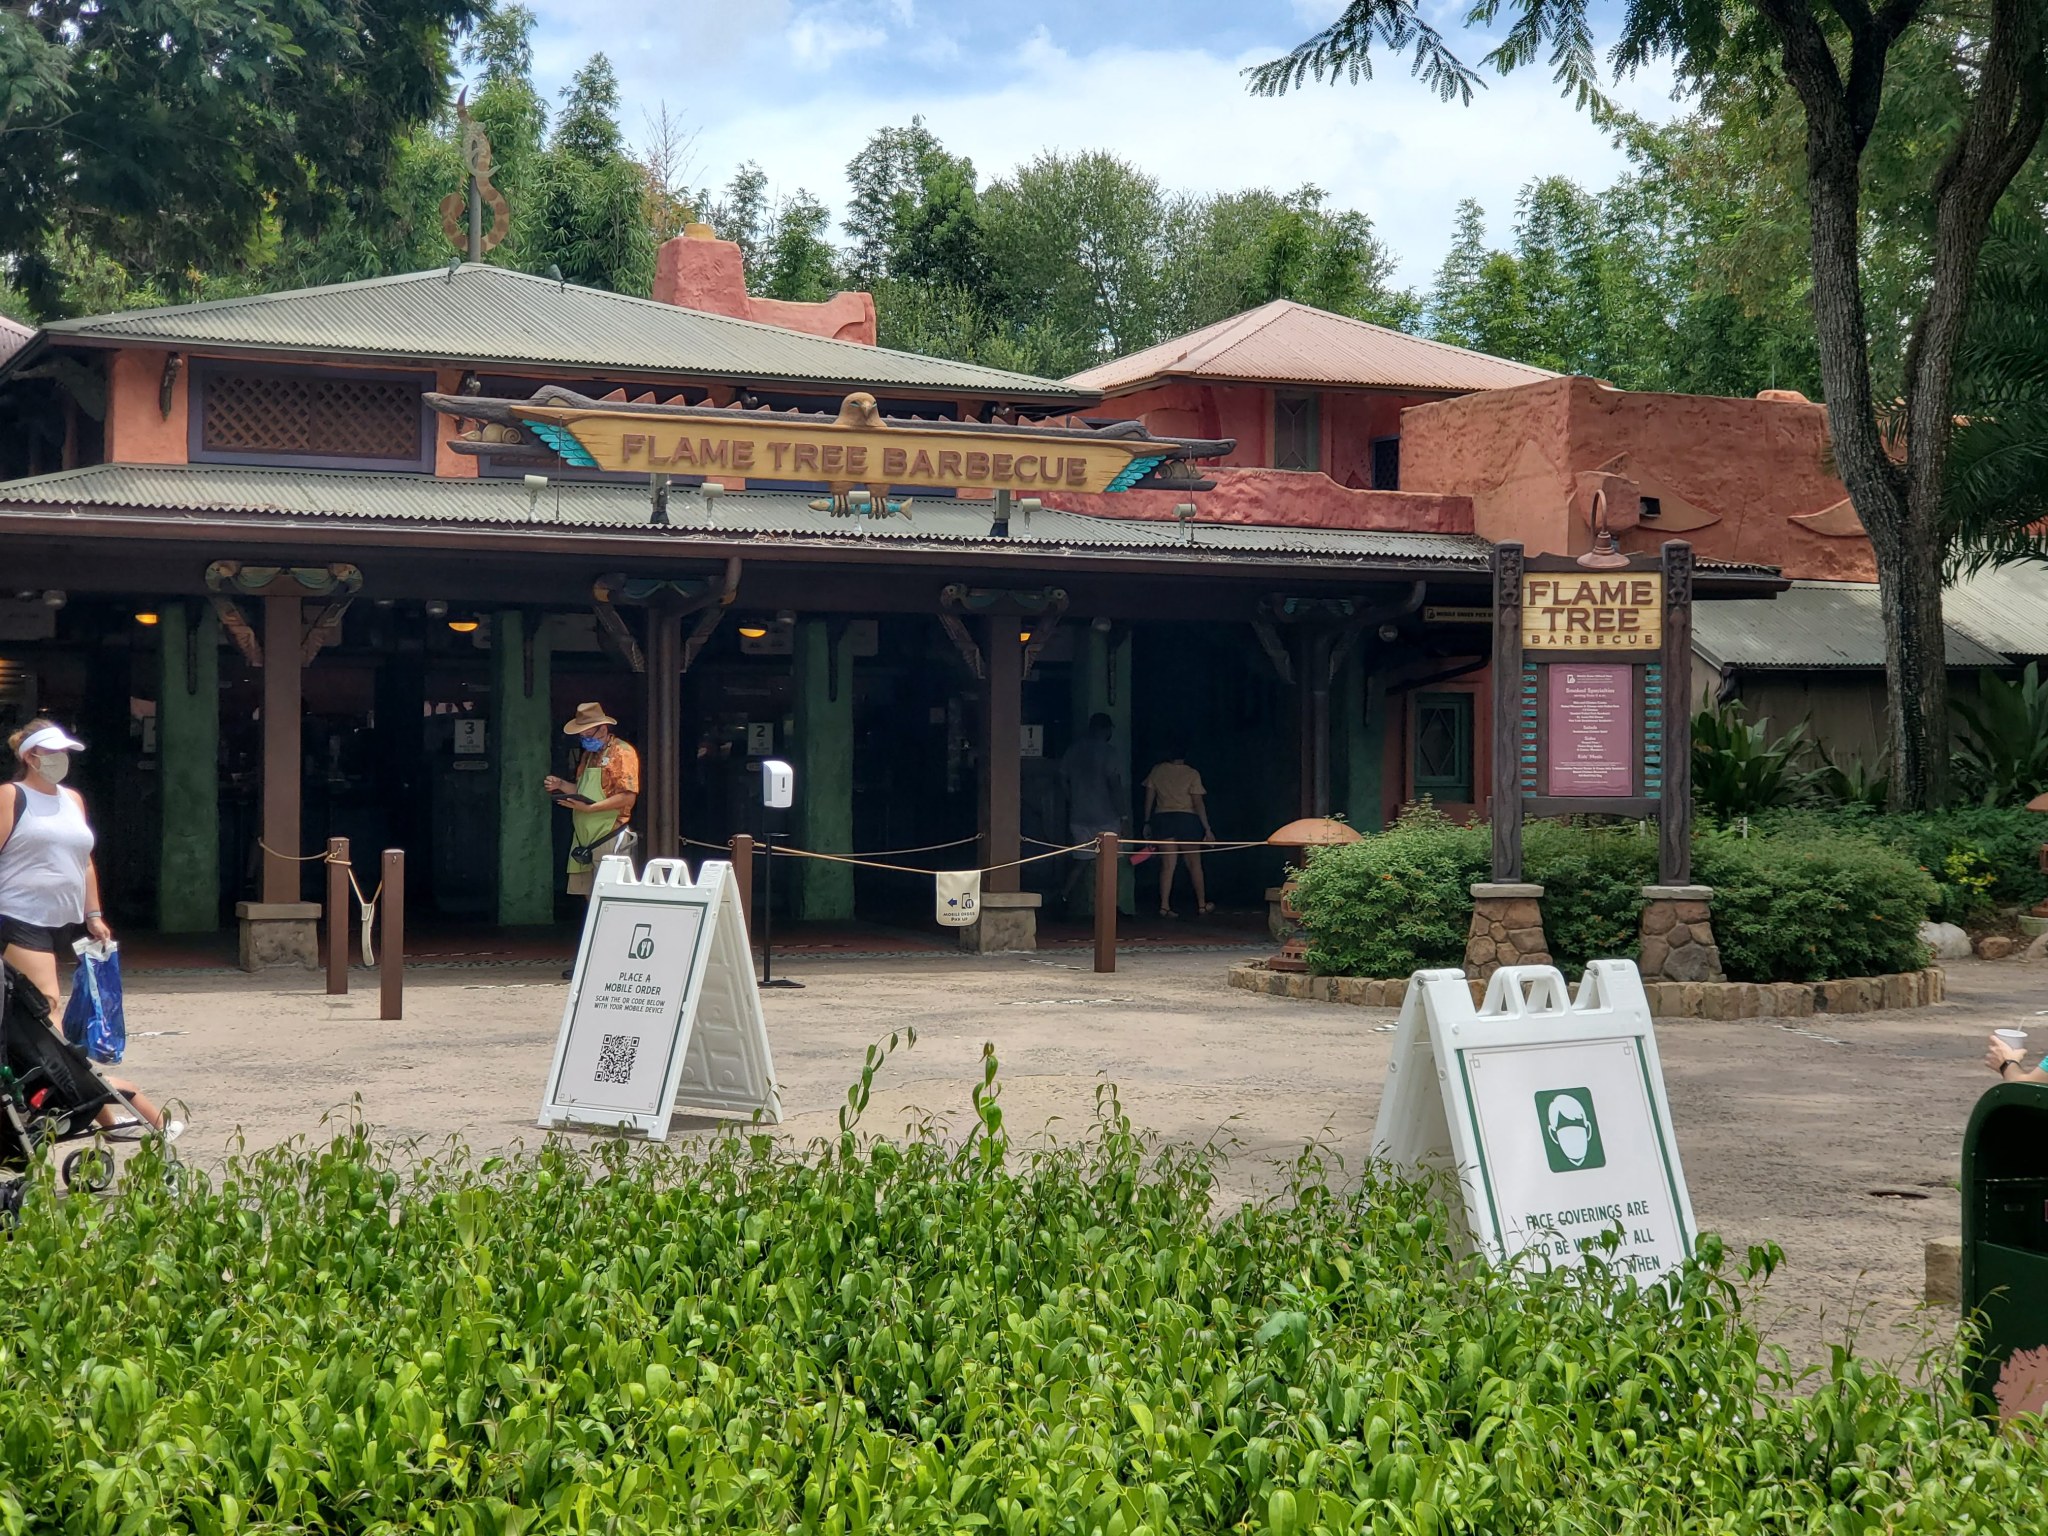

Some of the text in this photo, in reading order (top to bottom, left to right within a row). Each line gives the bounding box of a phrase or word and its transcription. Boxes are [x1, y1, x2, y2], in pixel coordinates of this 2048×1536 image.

[622, 433, 1087, 486] FLAME TREE BARBECUE
[1529, 581, 1653, 605] FLAME
[1542, 608, 1640, 632] TREE
[1531, 635, 1653, 644] BARBECUE
[464, 721, 475, 735] 3
[756, 725, 765, 738] 2
[1028, 727, 1033, 739] 1
[619, 972, 651, 983] PLACE A
[604, 983, 661, 995] MOBILE ORDER
[1526, 1200, 1650, 1230] FACE COVERINGS ARE
[1534, 1243, 1551, 1258] TO
[1555, 1240, 1570, 1256] BE
[1634, 1228, 1654, 1244] ALL
[1627, 1255, 1660, 1274] WHEN
